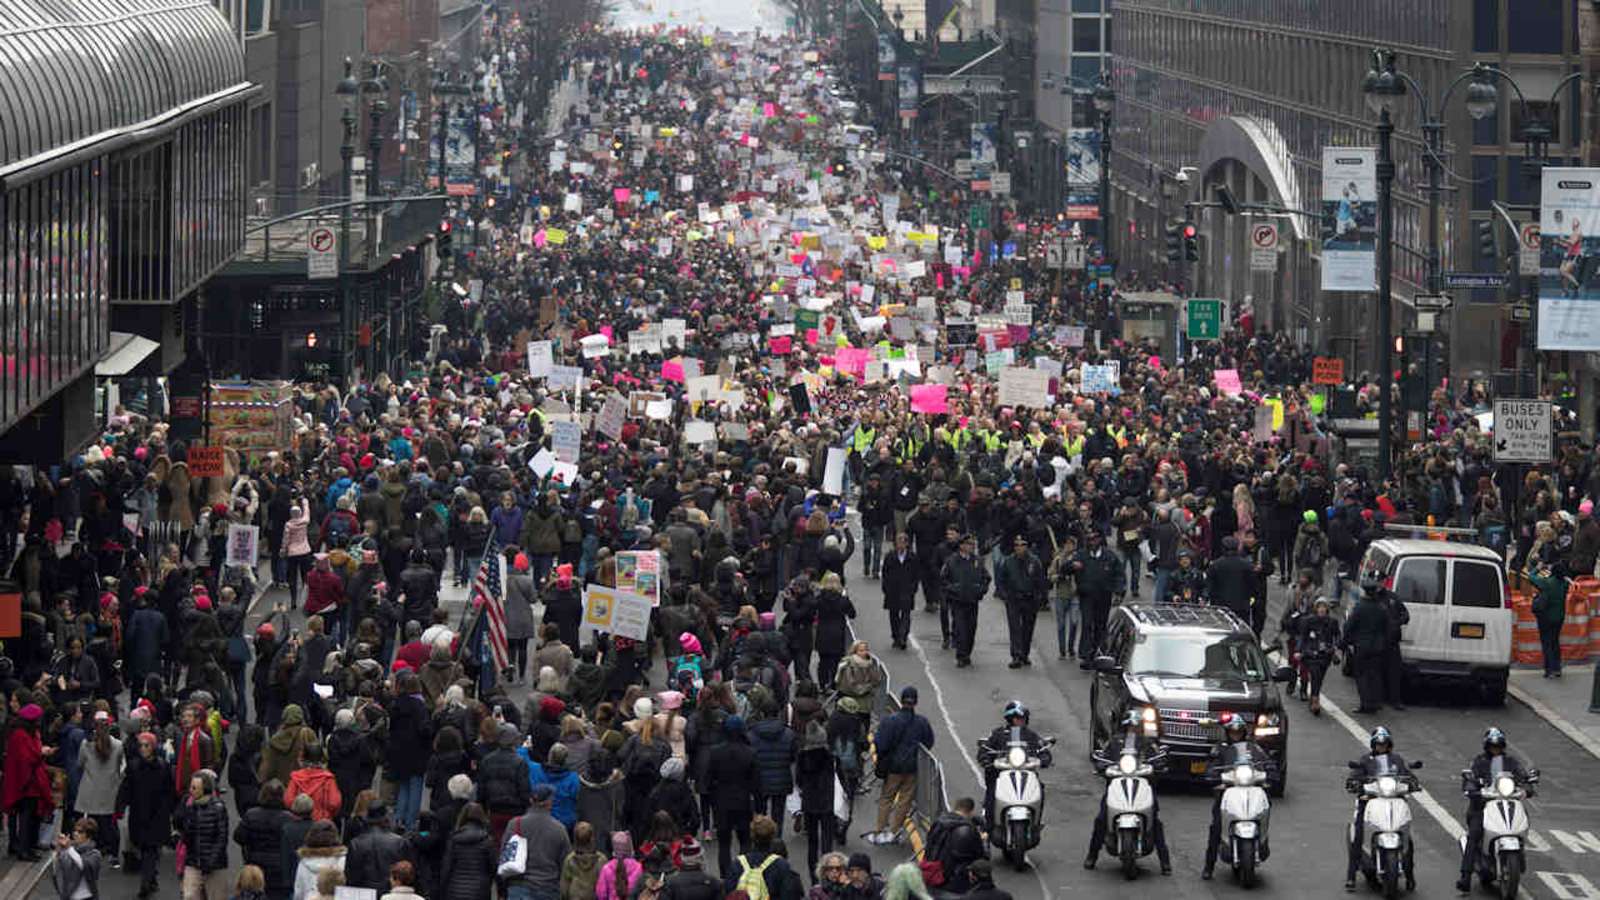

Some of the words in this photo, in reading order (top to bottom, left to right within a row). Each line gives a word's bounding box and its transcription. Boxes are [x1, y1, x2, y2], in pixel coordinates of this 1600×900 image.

[1501, 403, 1545, 416] BUSES
[1505, 418, 1538, 431] ONLY
[191, 450, 221, 461] RAISE
[190, 462, 221, 471] PLOW
